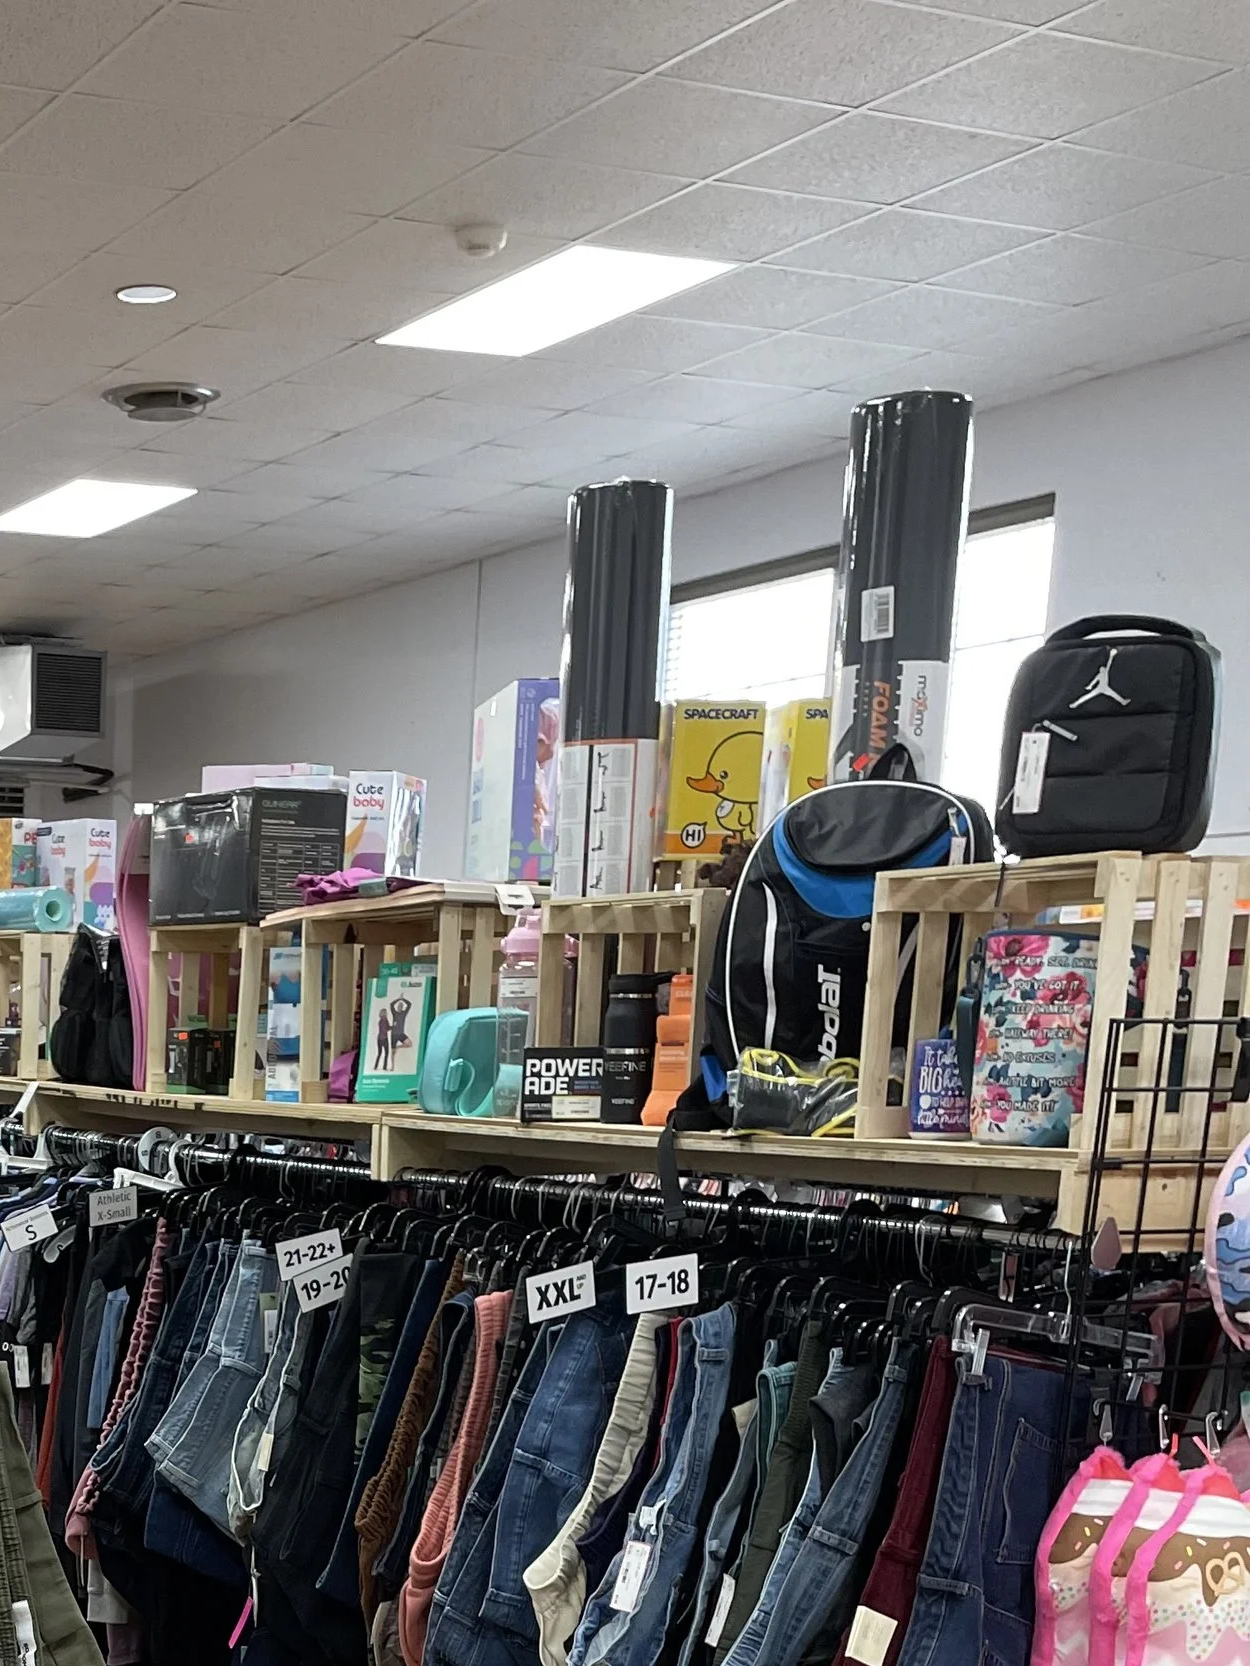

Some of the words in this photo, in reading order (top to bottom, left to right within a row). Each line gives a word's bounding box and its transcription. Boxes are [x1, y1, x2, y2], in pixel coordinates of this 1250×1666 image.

[684, 708, 759, 720] SPACECRAFT
[869, 680, 891, 749] FOAM
[356, 783, 384, 796] Cute
[353, 797, 385, 810] baby
[685, 830, 701, 842] HI
[1049, 980, 1068, 991] GOT
[1070, 980, 1080, 991] IT
[525, 1058, 603, 1077] POWER
[524, 1077, 569, 1095] ADE
[919, 1067, 943, 1093] BIG
[97, 1191, 132, 1206] Athletic
[97, 1208, 132, 1222] X-Small
[25, 1224, 38, 1241] S
[283, 1242, 336, 1268] 21-22+
[635, 1269, 690, 1301] 17-18
[535, 1277, 581, 1311] XXL
